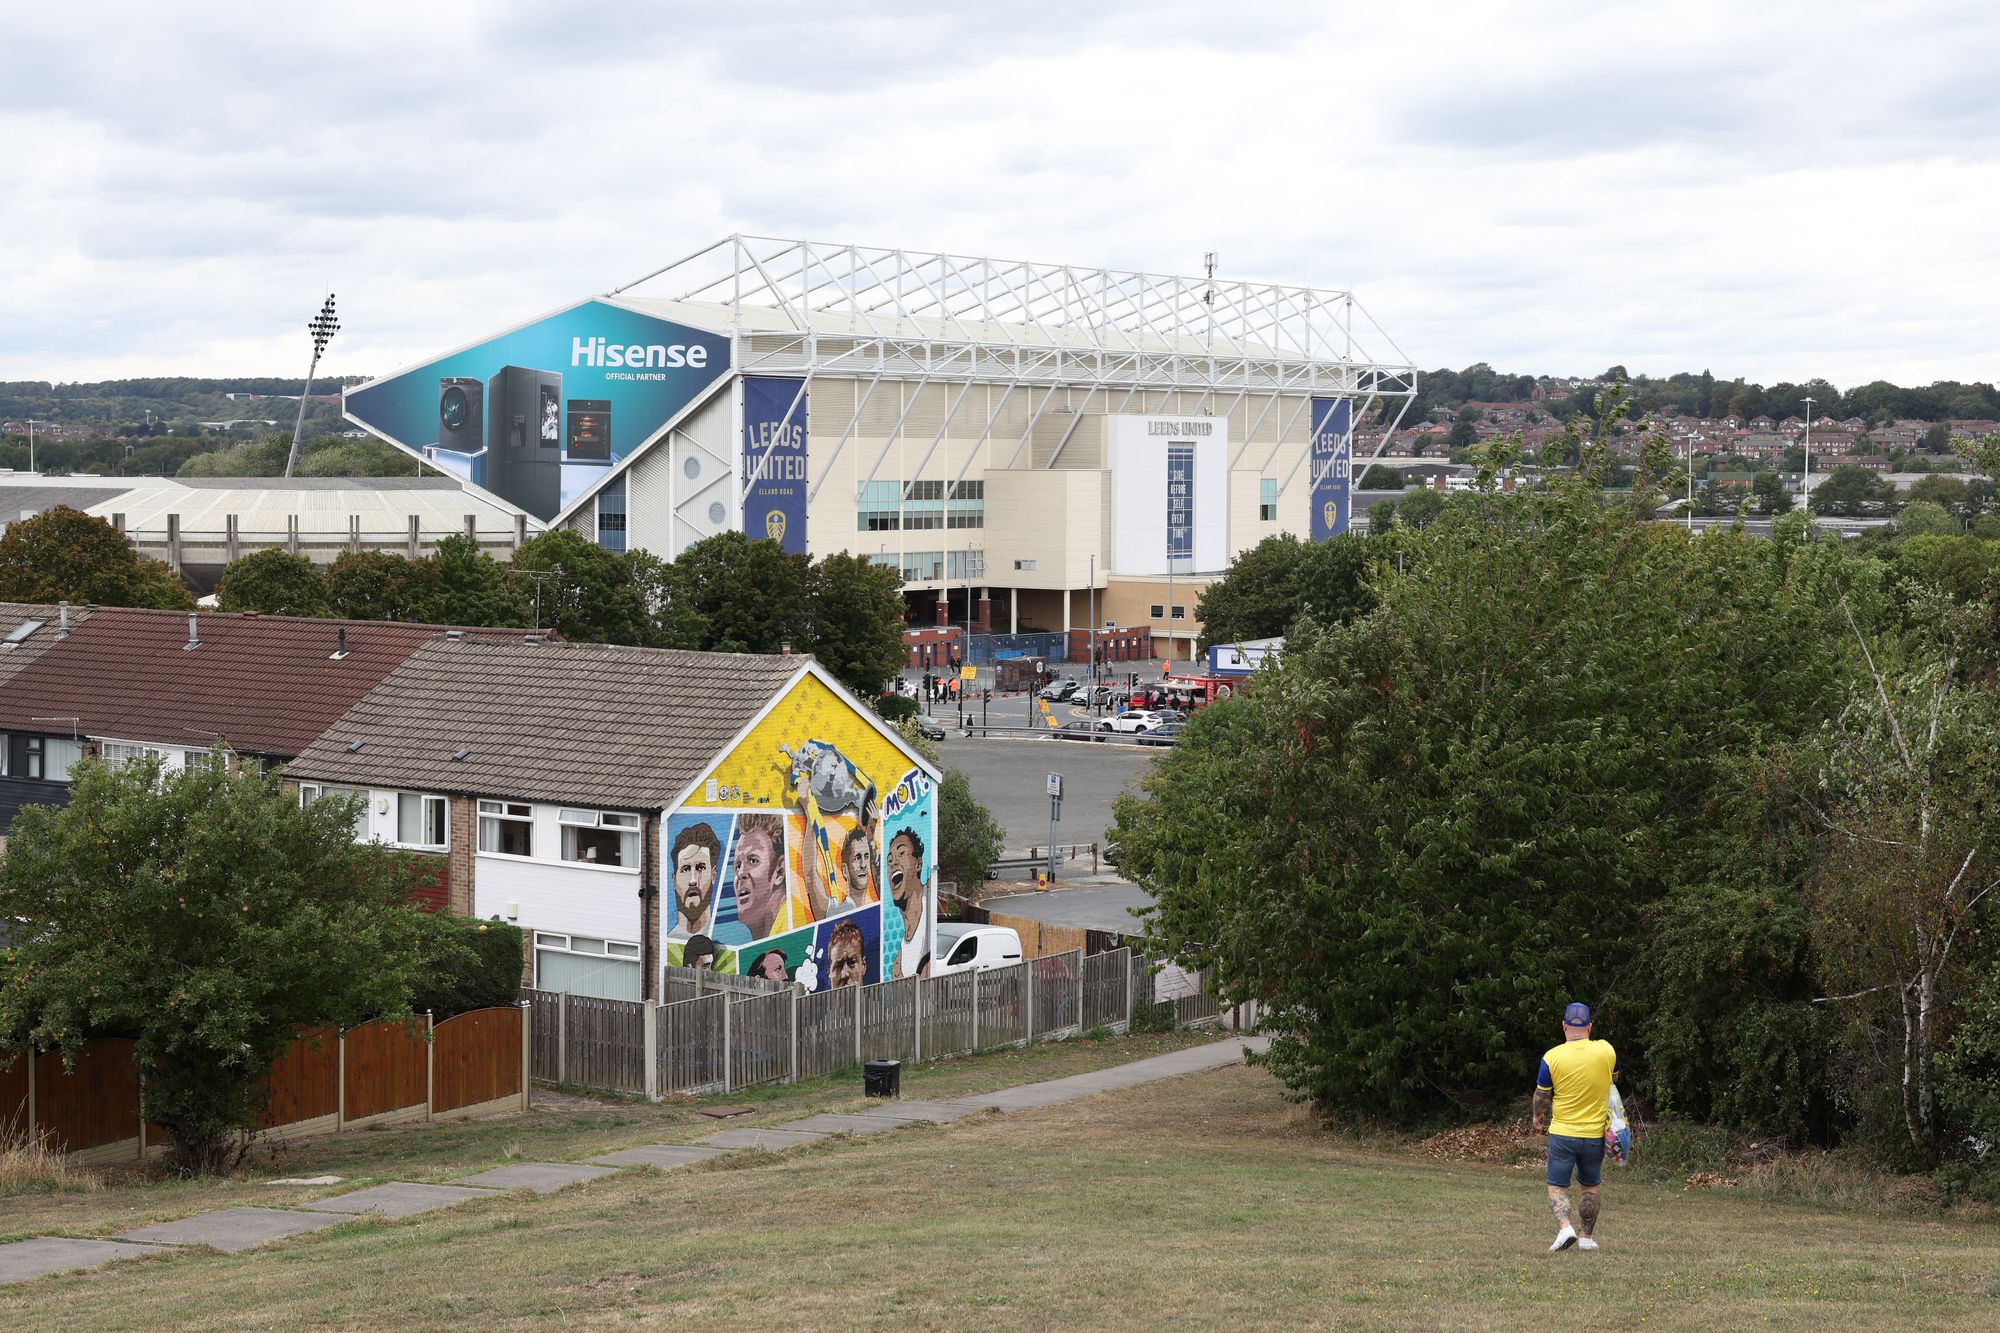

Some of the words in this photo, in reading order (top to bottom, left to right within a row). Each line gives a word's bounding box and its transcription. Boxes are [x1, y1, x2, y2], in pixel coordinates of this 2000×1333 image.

[571, 336, 708, 368] Hisense
[605, 372, 636, 381] OFFICIAL
[636, 373, 666, 381] PARTNER
[1148, 421, 1180, 436] LEEDS
[1181, 421, 1213, 436] UNITED
[749, 421, 803, 450] LEEDS
[746, 455, 805, 480] UNITED
[758, 488, 779, 496] ELLAND
[779, 488, 794, 496] ROAD
[1170, 484, 1187, 495] BEFORE
[1173, 498, 1184, 509] SELF
[1171, 513, 1185, 524] EVERY
